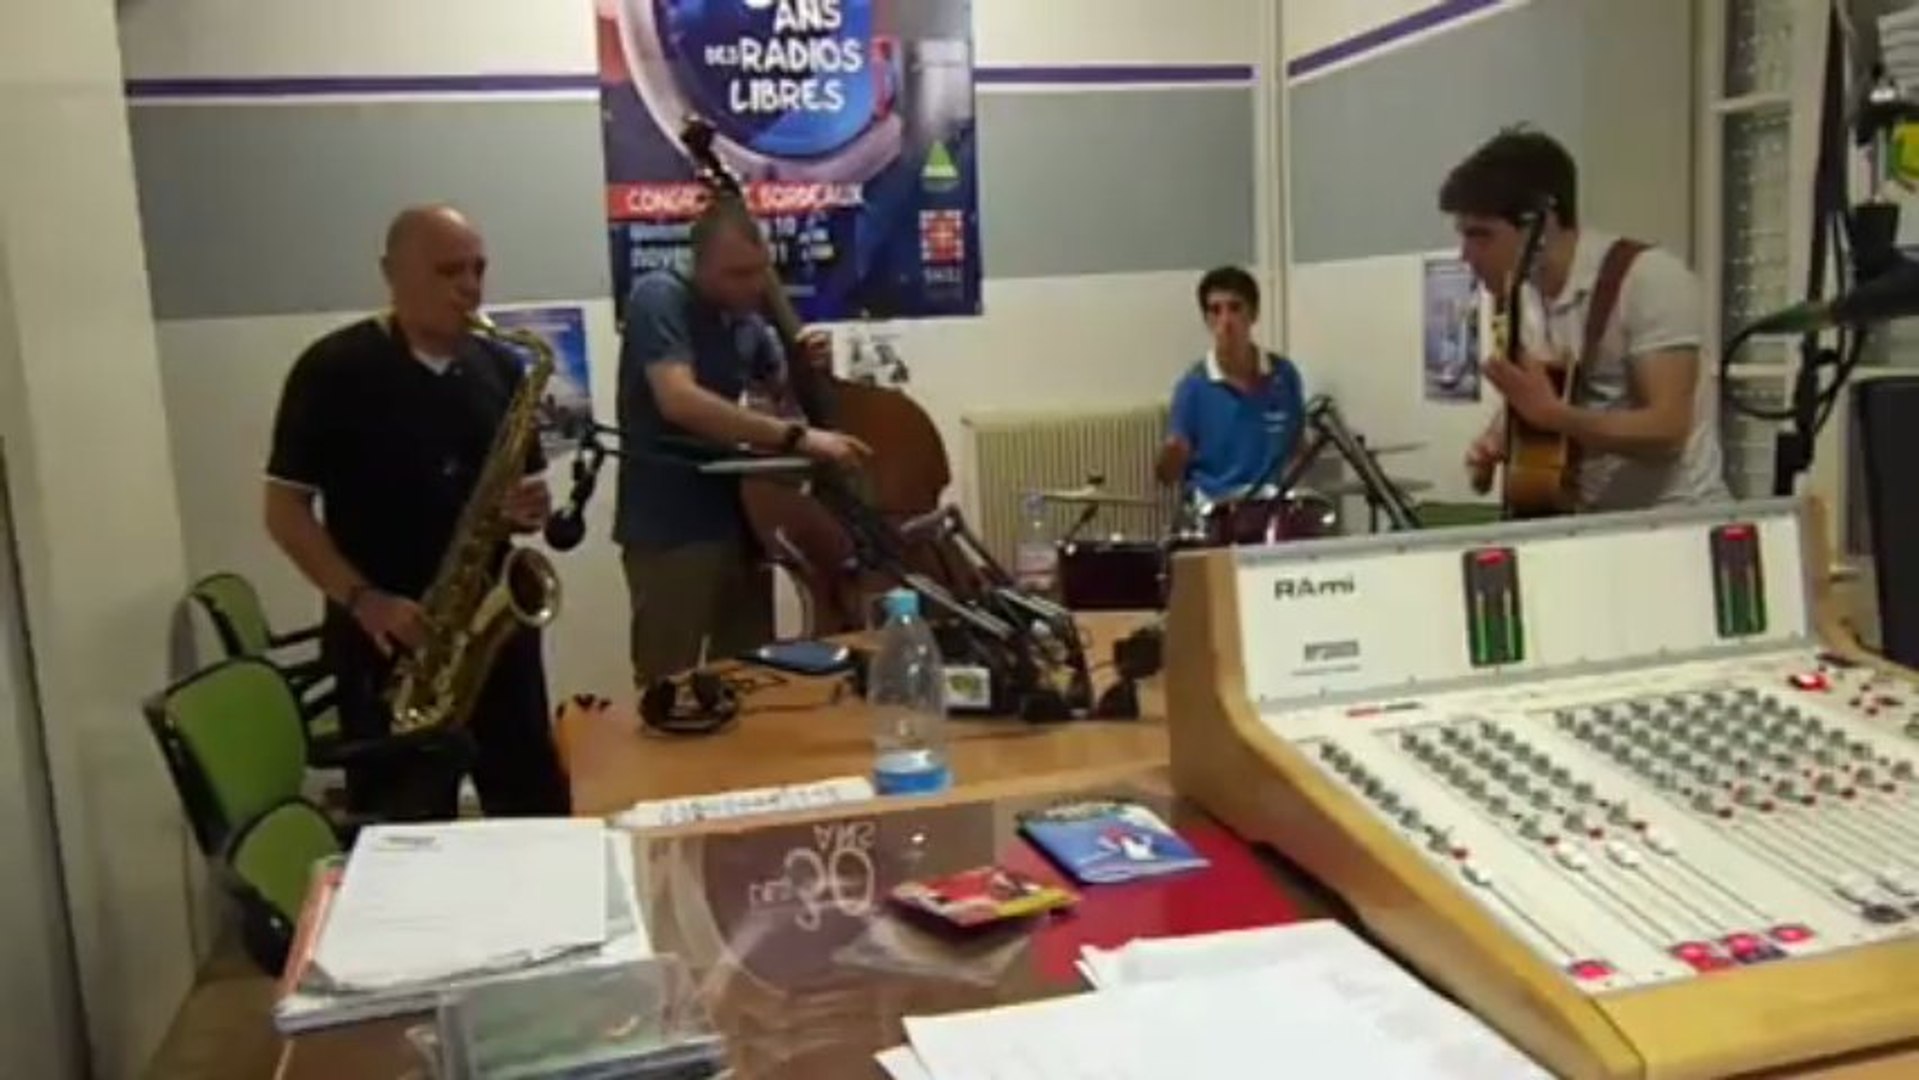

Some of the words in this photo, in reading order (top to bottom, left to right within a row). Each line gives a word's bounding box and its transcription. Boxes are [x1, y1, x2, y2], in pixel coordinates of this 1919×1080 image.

[773, 0, 842, 34] ANS
[739, 36, 863, 73] RADIOS
[730, 78, 845, 112] LIBRES
[1274, 574, 1355, 600] RAmi
